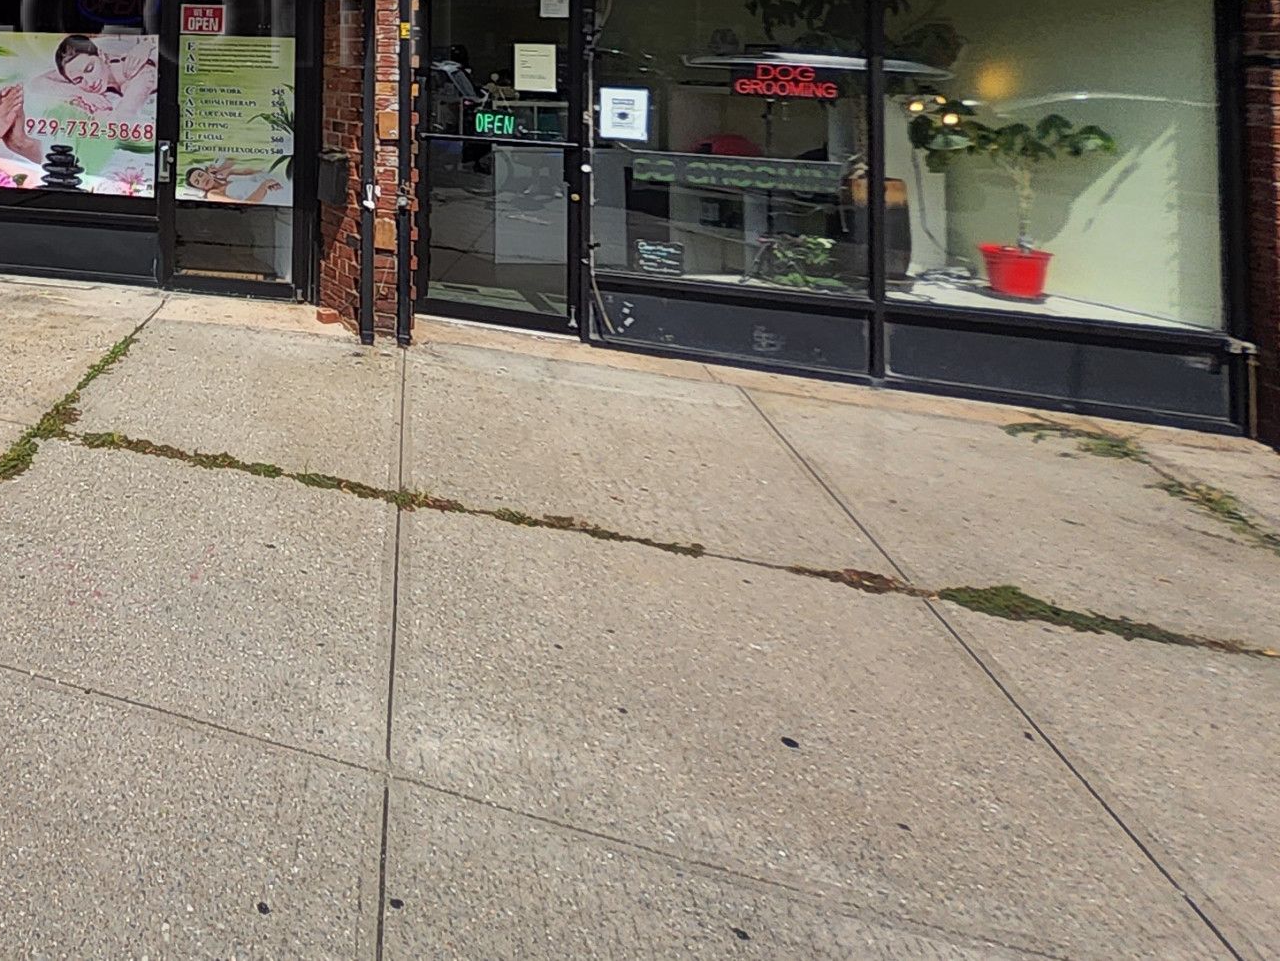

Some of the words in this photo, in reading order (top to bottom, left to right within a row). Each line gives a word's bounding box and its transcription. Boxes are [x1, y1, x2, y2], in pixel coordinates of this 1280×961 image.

[188, 17, 219, 31] OPEN
[756, 64, 816, 81] DOG
[735, 79, 838, 98] GROOMING
[26, 119, 154, 141] 929-732-5868
[476, 113, 515, 135] OPEN
